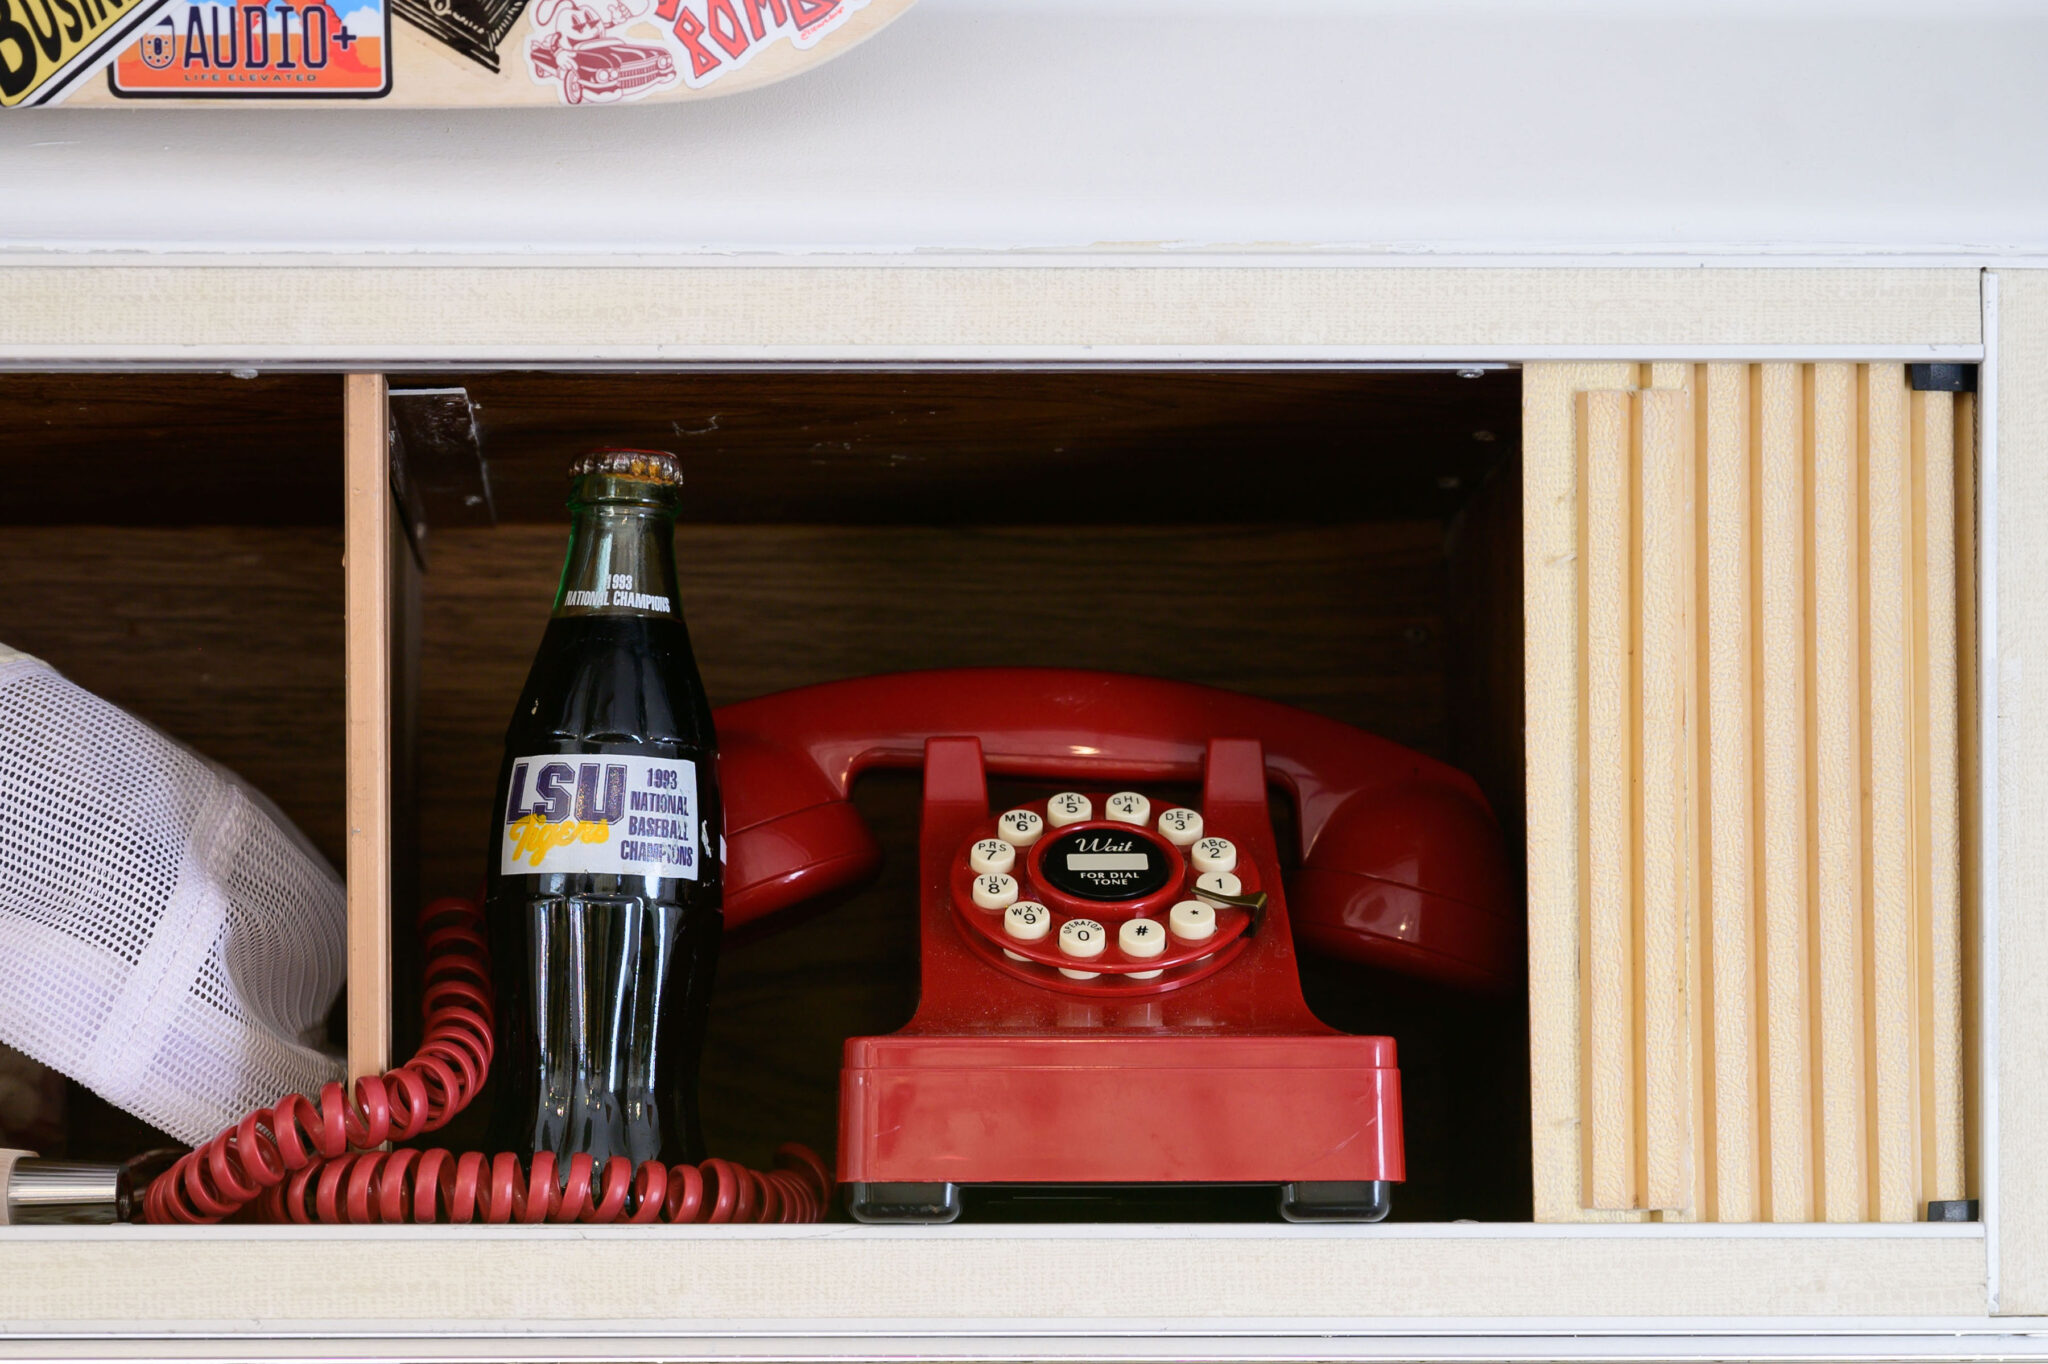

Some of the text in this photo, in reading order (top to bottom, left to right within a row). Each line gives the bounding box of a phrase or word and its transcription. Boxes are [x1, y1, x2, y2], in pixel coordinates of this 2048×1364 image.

[606, 574, 633, 590] 1993
[565, 590, 671, 614] NATIONAL CHAMPIONS
[646, 767, 678, 790] 1993
[506, 761, 628, 826] LSU
[630, 791, 689, 817] NATIONAL
[1066, 802, 1078, 813] 5
[1122, 803, 1133, 814] 4
[628, 815, 689, 842] BASEBALL
[1016, 820, 1029, 831] 6
[1175, 820, 1186, 830] 3
[509, 812, 610, 867] Tigers
[1075, 838, 1133, 852] Wait
[620, 839, 694, 868] CHAMPIONS
[985, 849, 997, 861] 7
[1209, 848, 1221, 858] 2
[988, 883, 1000, 894] 8
[1216, 878, 1222, 889] 1
[1023, 913, 1036, 924] 9
[1063, 920, 1102, 934] OPERATOR
